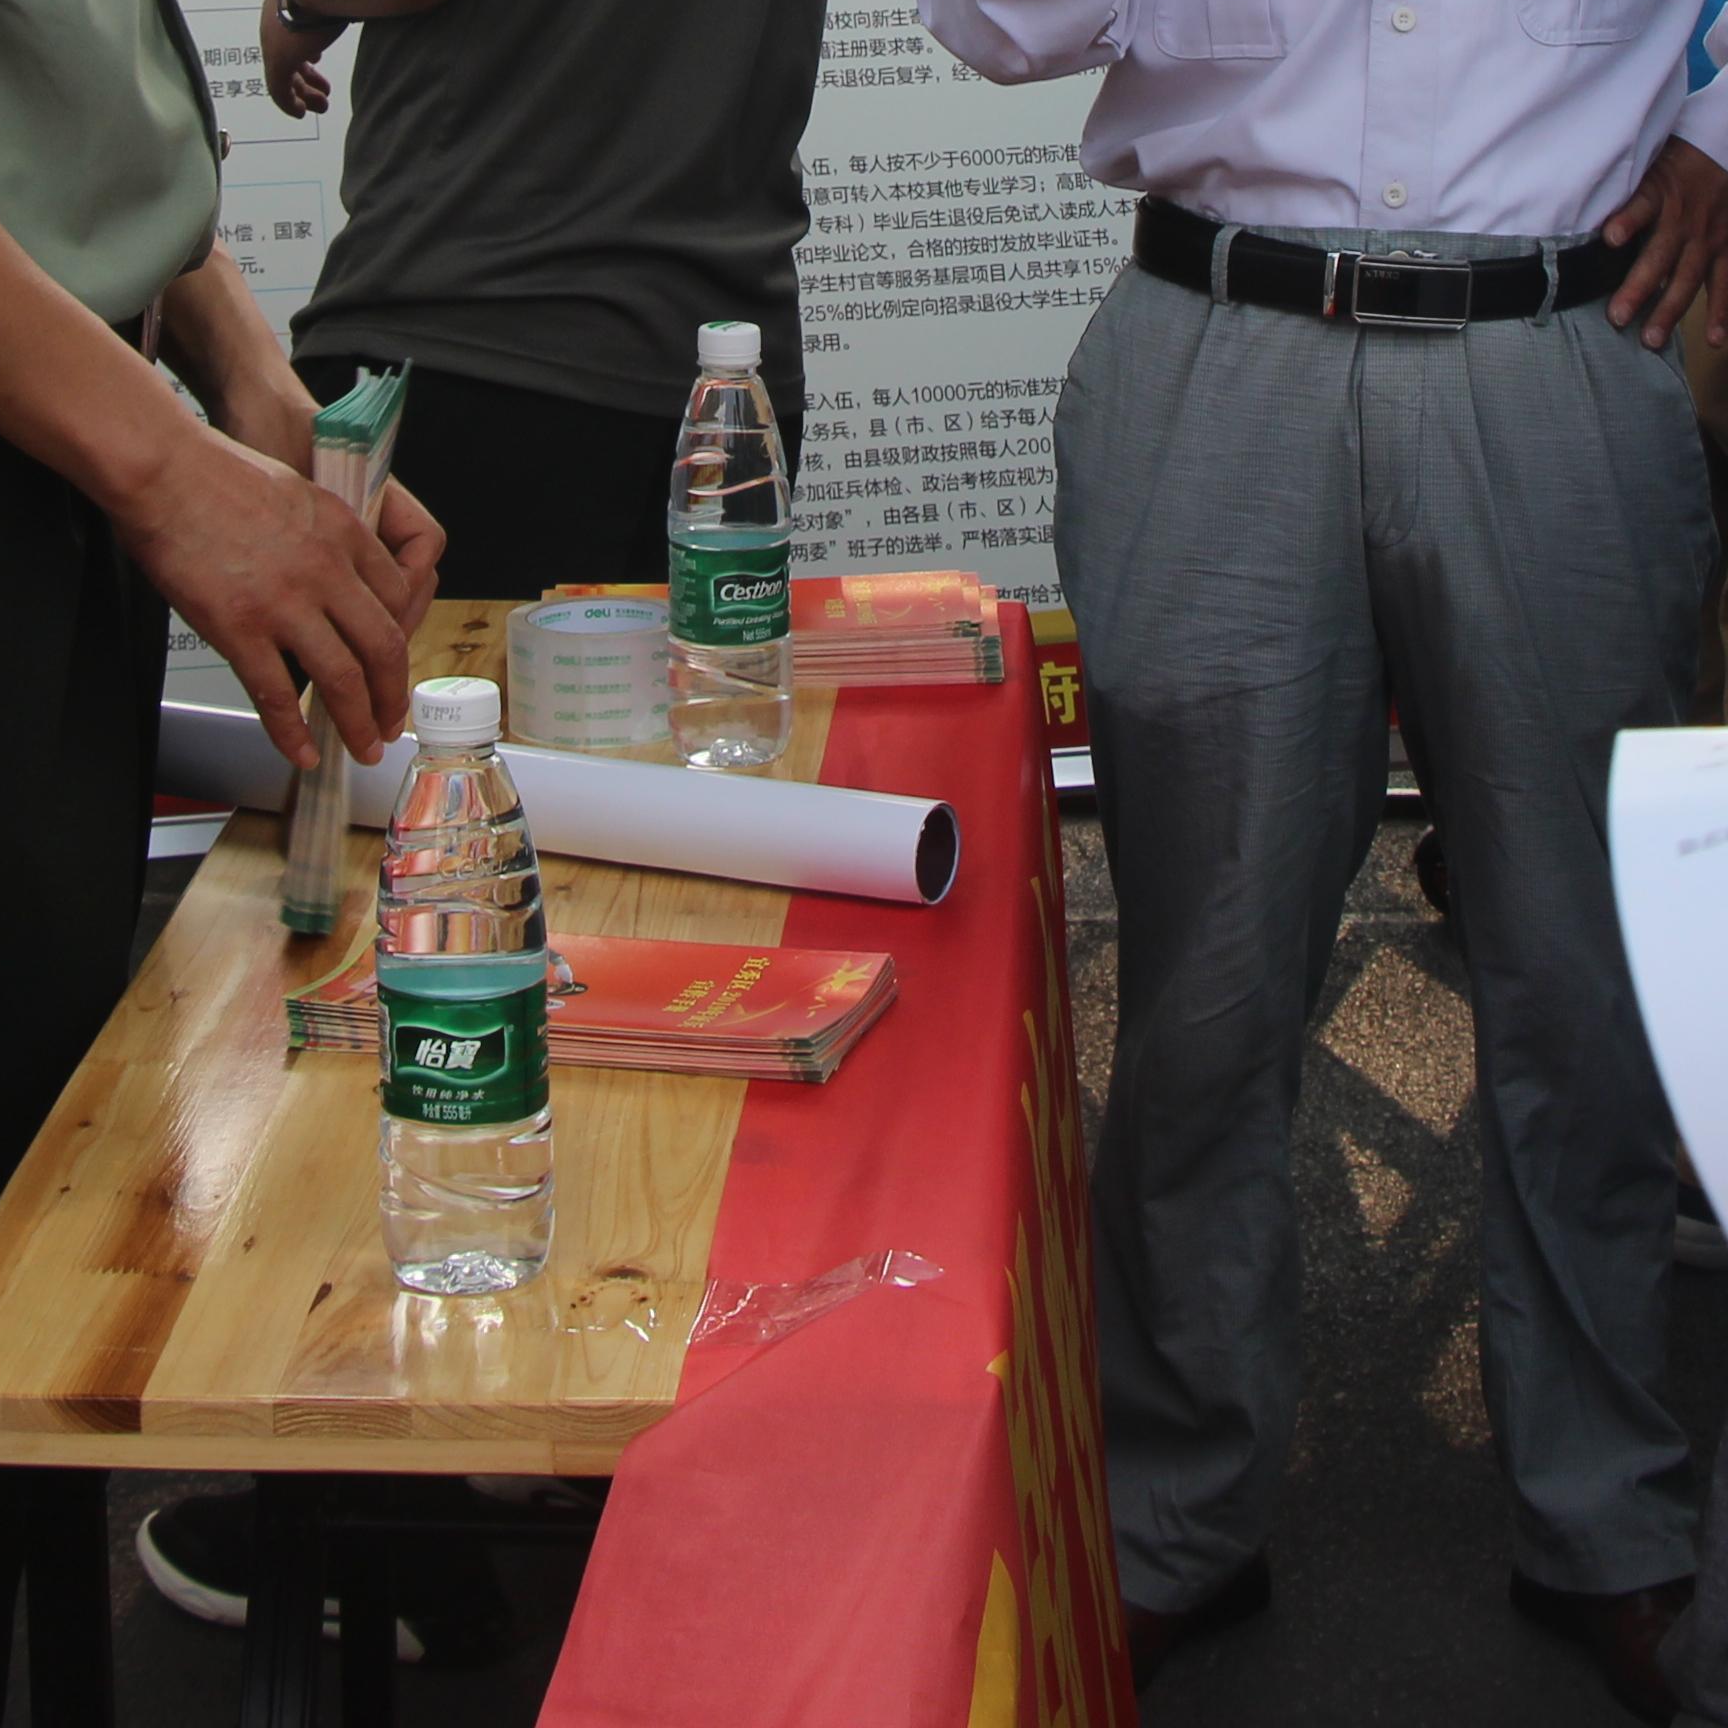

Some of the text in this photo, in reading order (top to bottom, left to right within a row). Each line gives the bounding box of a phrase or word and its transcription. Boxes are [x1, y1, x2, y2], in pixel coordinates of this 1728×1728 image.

[208, 78, 270, 99] 定享受
[802, 141, 1083, 177] 伍，每人按不少于6000元的标准
[807, 196, 1141, 237] 专科）毕业后生退役后免试入读成人本
[798, 282, 1106, 323] 25%的比例定向招录退役大学生士兵
[797, 436, 1052, 473] 核，由县级财政按照每人200
[584, 608, 611, 619] deli
[1039, 661, 1080, 725] 府
